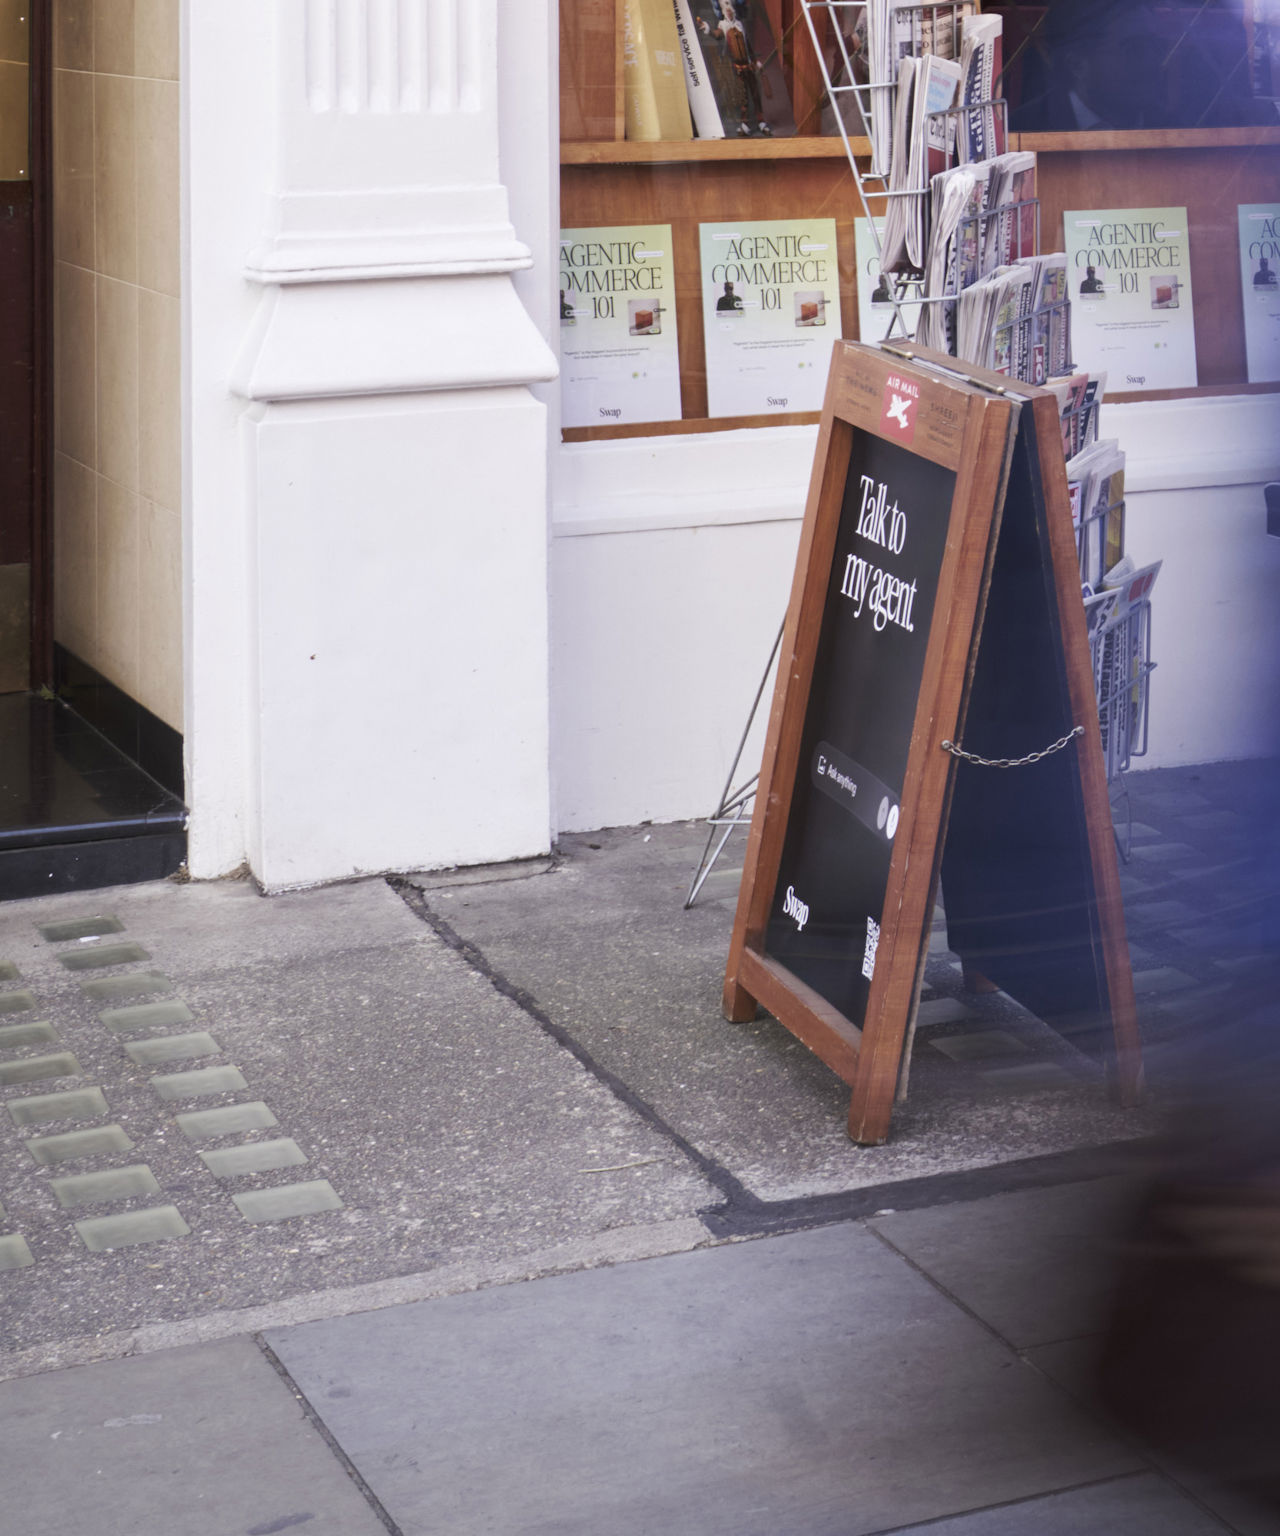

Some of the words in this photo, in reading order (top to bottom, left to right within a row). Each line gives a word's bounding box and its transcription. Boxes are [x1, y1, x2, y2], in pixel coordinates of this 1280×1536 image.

[1088, 222, 1166, 246] AGENTIC
[560, 241, 646, 267] AGENTIC
[726, 235, 811, 260] AGENTIC
[1076, 246, 1181, 269] COMMERCE
[560, 267, 663, 293] OMMERCE
[712, 260, 828, 285] COMMERCE
[1120, 272, 1139, 293] 101
[592, 296, 615, 319] 101
[761, 288, 781, 311] 101
[767, 396, 789, 407] Swap
[900, 382, 919, 398] MAIL
[599, 407, 622, 419] Swap
[855, 475, 891, 548] Talk
[888, 499, 907, 555] to
[840, 554, 873, 619] my
[869, 578, 918, 633] agent.
[827, 763, 838, 783] Ask
[836, 773, 857, 798] anything
[783, 885, 809, 931] Swap
